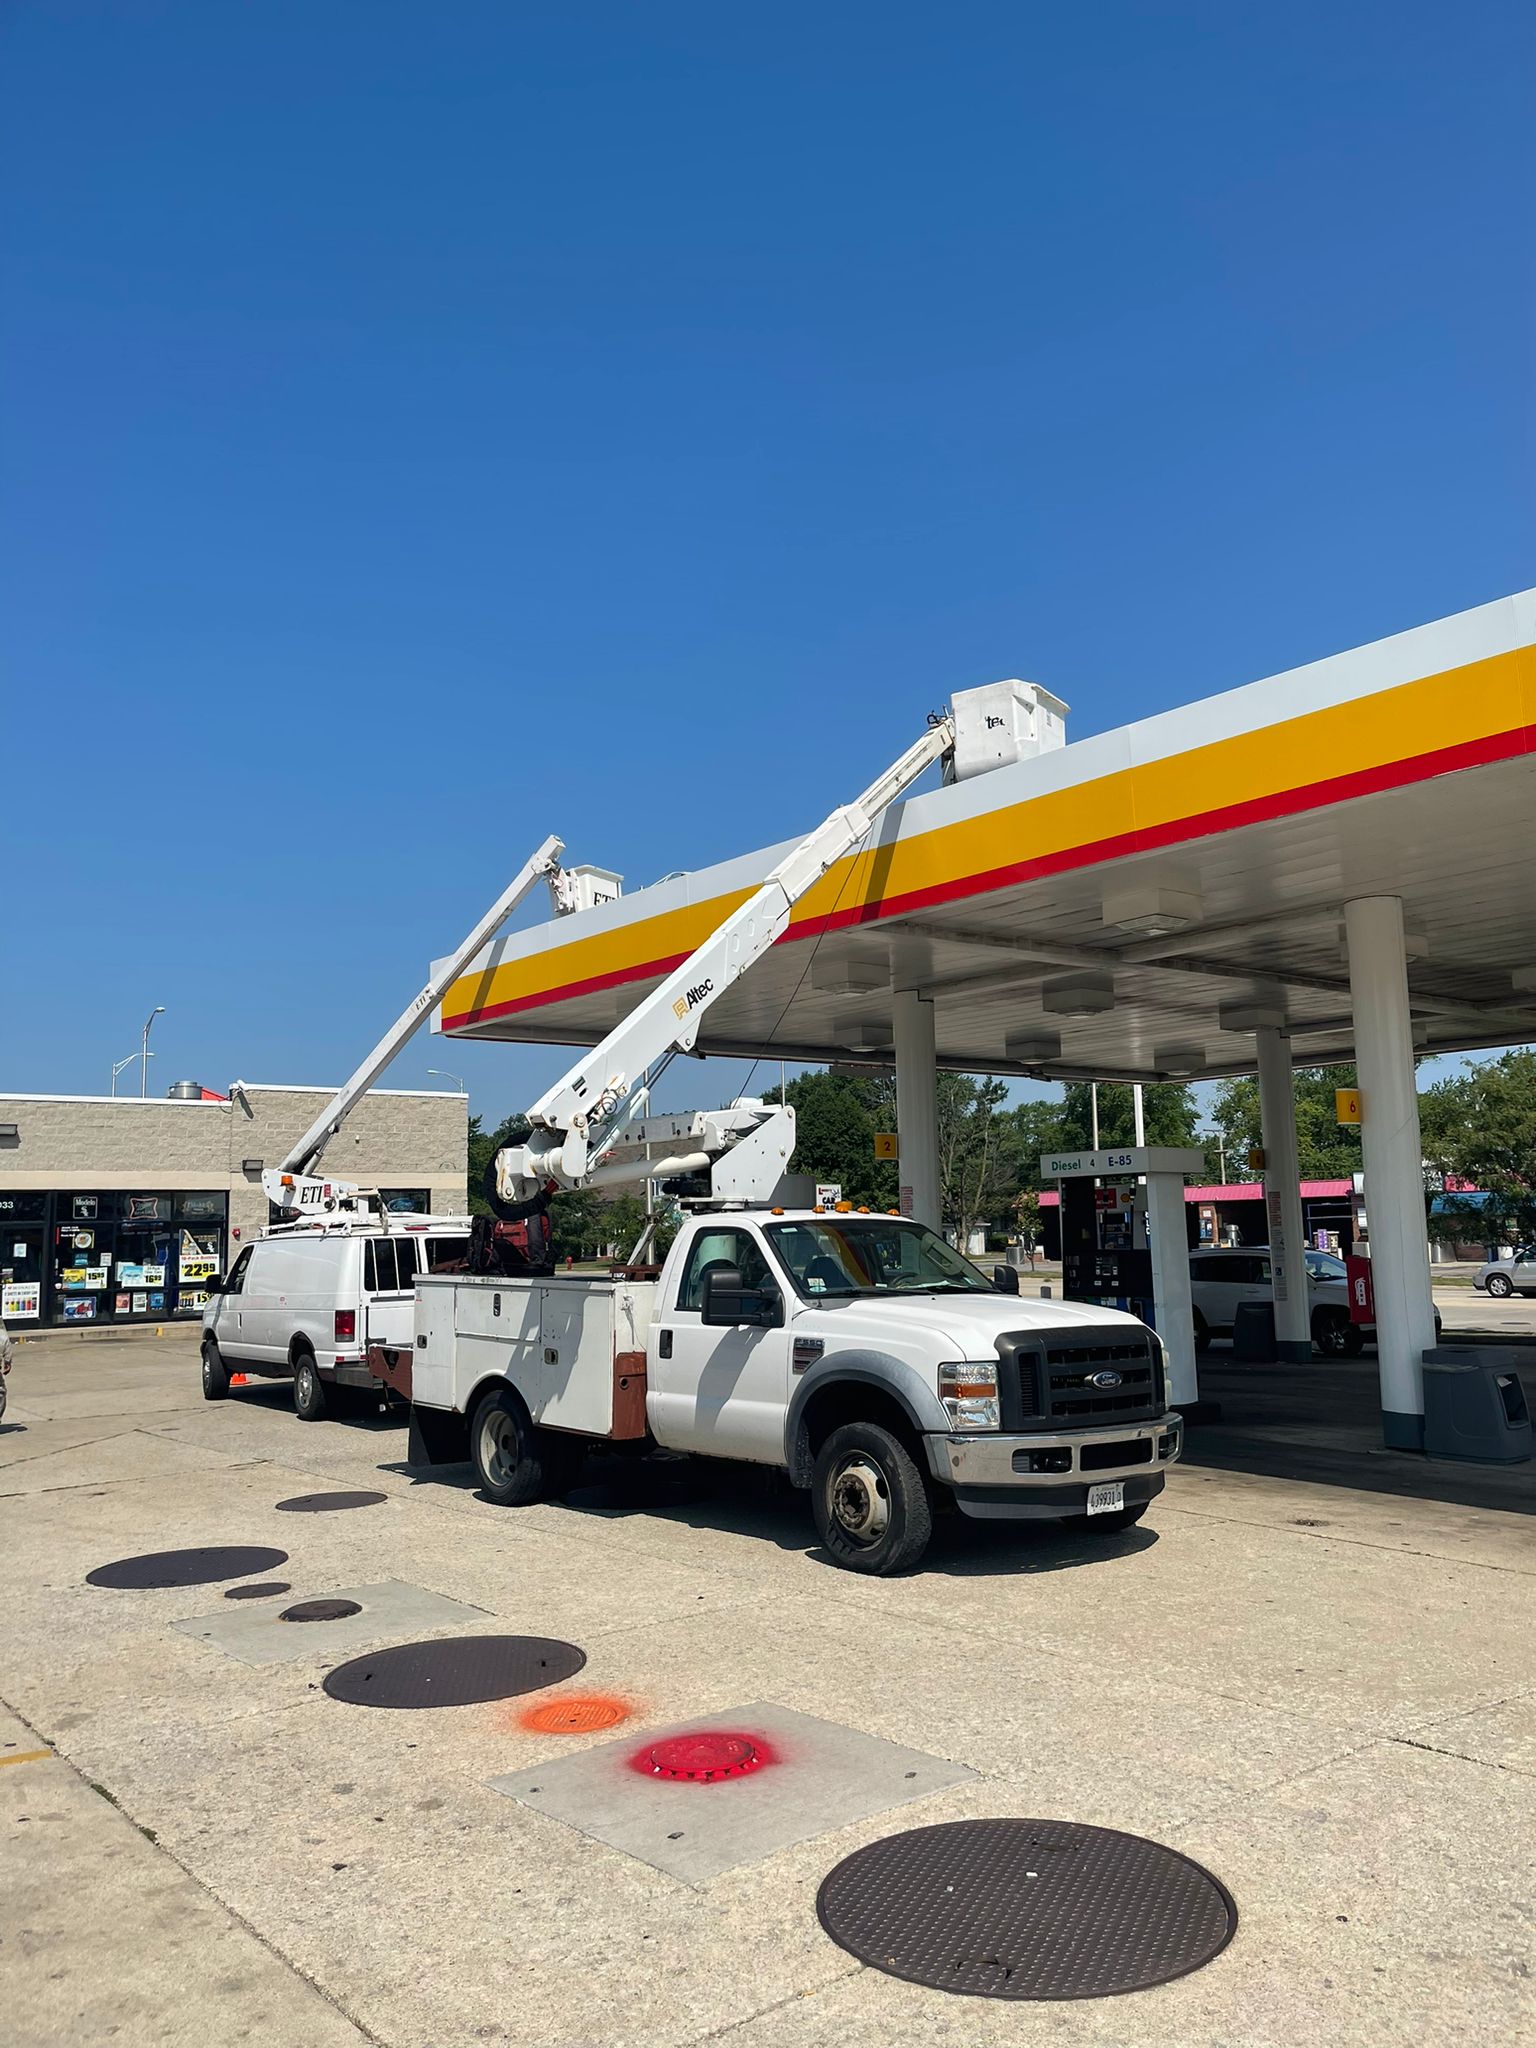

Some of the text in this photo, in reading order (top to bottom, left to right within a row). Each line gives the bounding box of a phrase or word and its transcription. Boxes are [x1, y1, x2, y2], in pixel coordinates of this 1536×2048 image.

[686, 978, 714, 1010] Altec
[1350, 1101, 1356, 1113] 6
[884, 1141, 891, 1152] 2
[1052, 1155, 1132, 1171] Diesel 4 E-85
[300, 1186, 323, 1204] ETI
[822, 1197, 836, 1205] CAR
[1101, 1374, 1116, 1385] Ford
